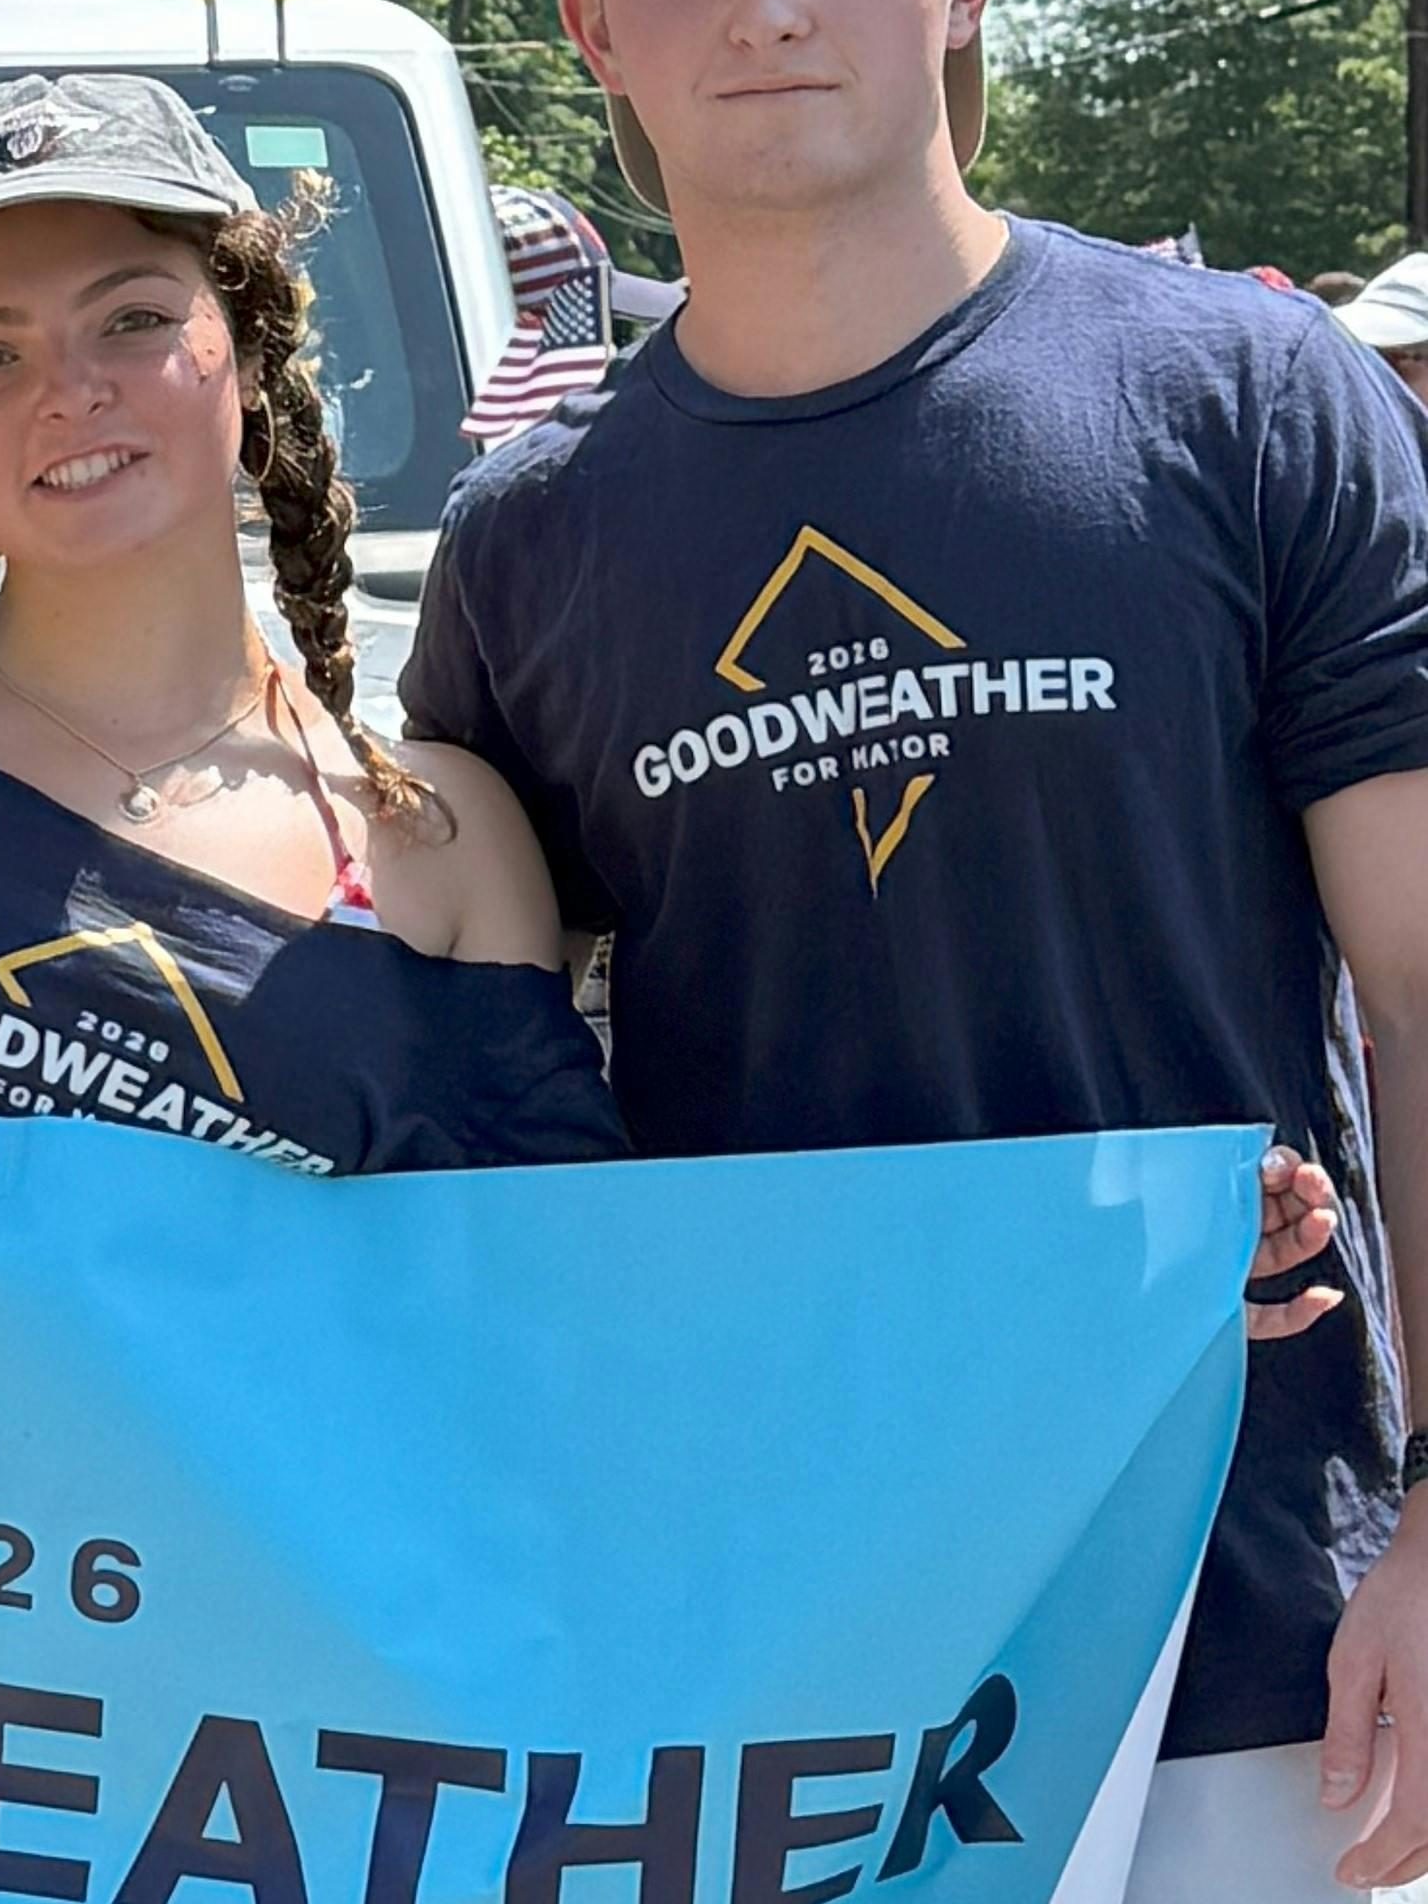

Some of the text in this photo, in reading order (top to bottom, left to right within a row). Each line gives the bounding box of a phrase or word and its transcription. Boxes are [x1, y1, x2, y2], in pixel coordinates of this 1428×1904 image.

[634, 657, 1116, 798] GOODWEATHER
[771, 757, 839, 792] FOR
[76, 1011, 169, 1063] 2026
